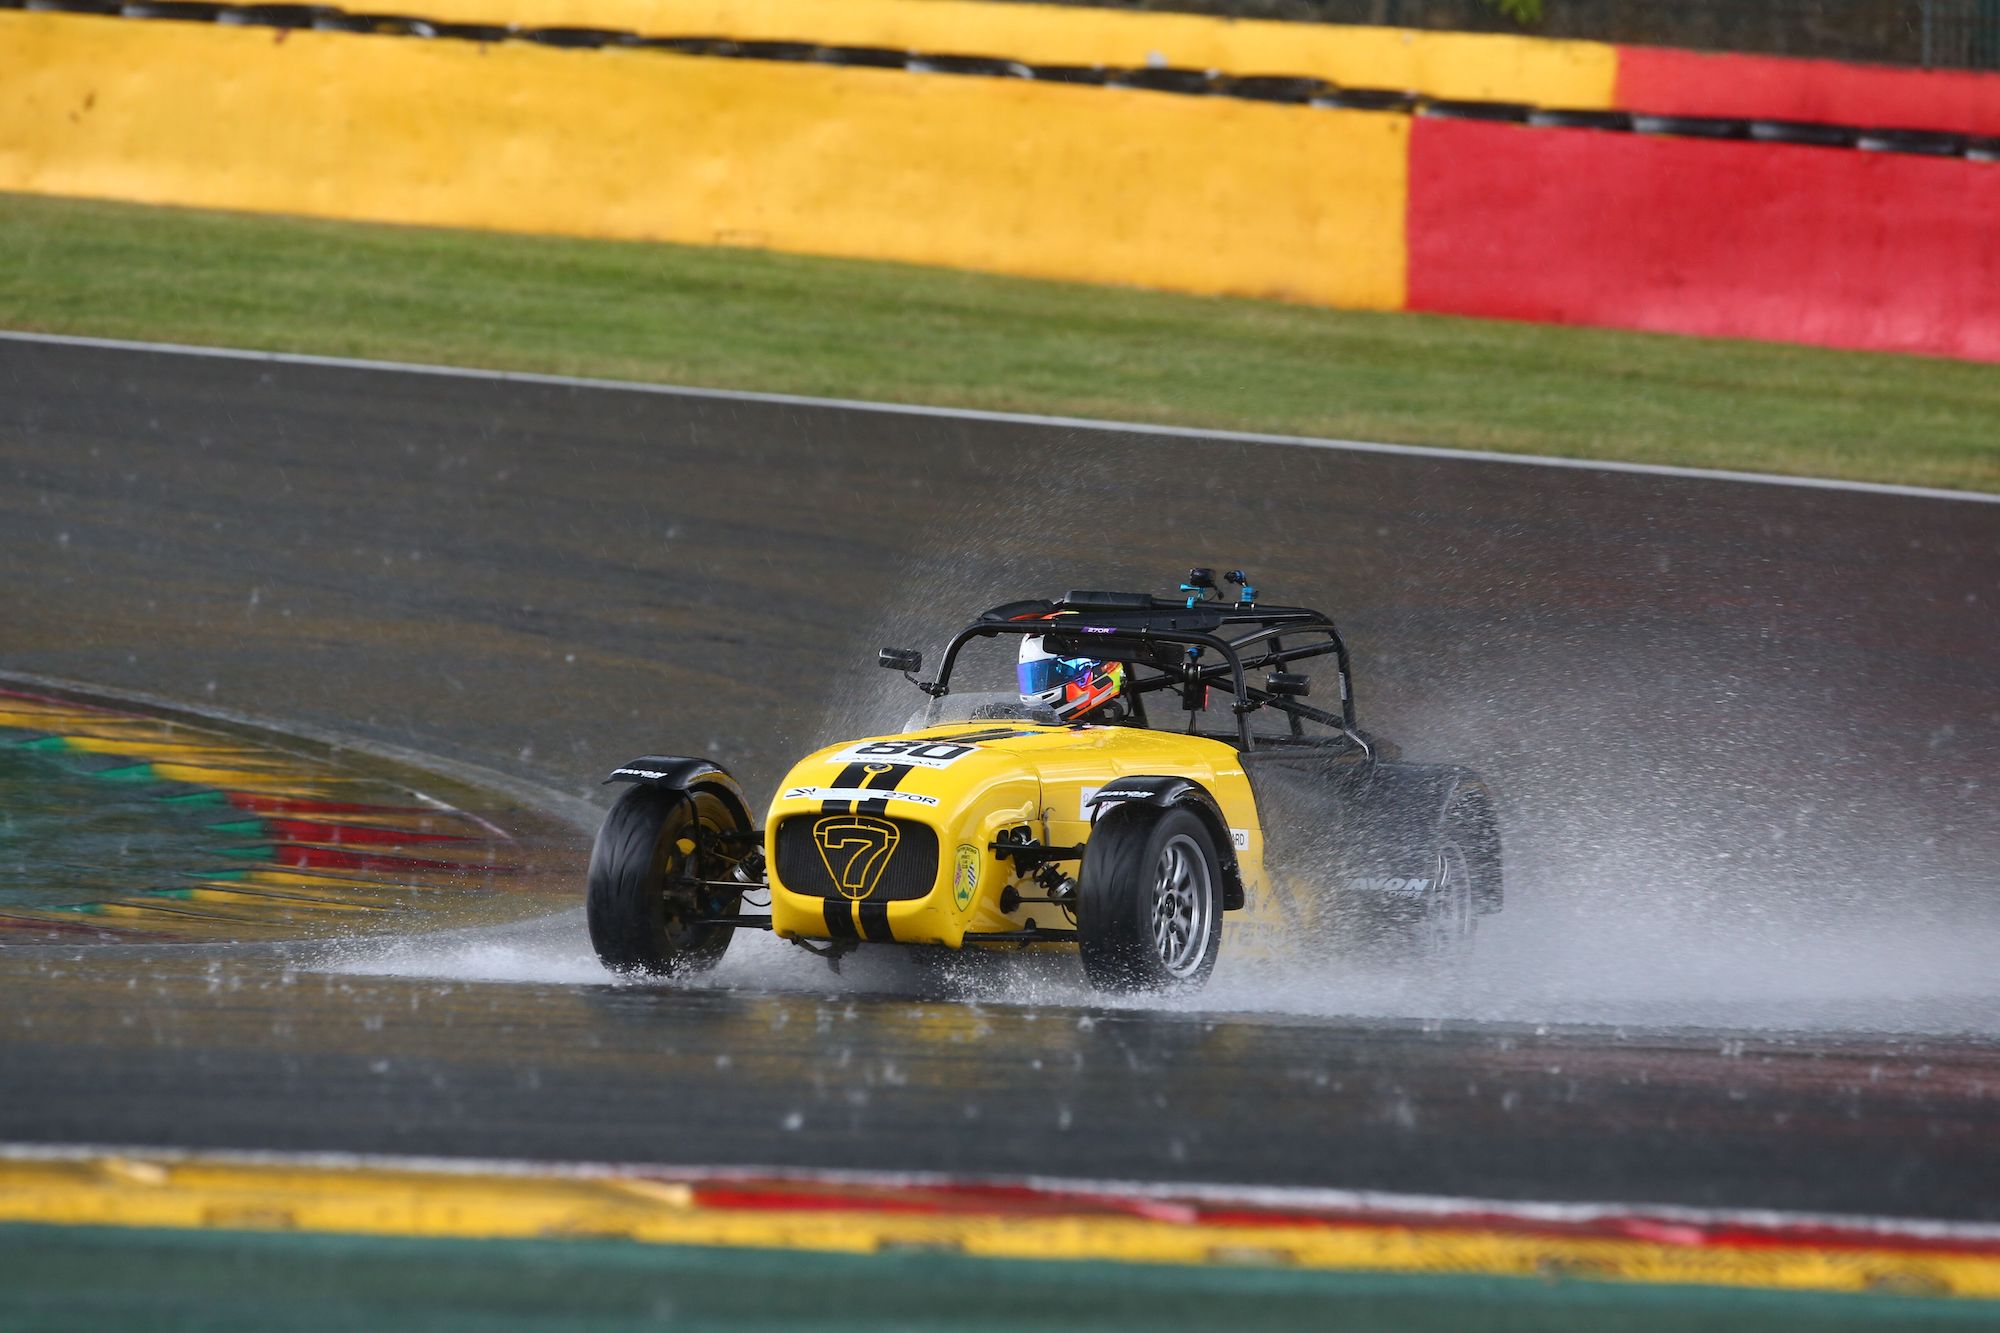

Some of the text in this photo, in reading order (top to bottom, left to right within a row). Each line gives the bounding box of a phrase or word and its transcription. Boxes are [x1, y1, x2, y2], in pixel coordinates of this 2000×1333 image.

[855, 741, 976, 760] 80
[835, 756, 942, 767] ATERHAM
[882, 792, 937, 805] 270R
[824, 824, 889, 889] 7
[1346, 877, 1430, 891] AVON
